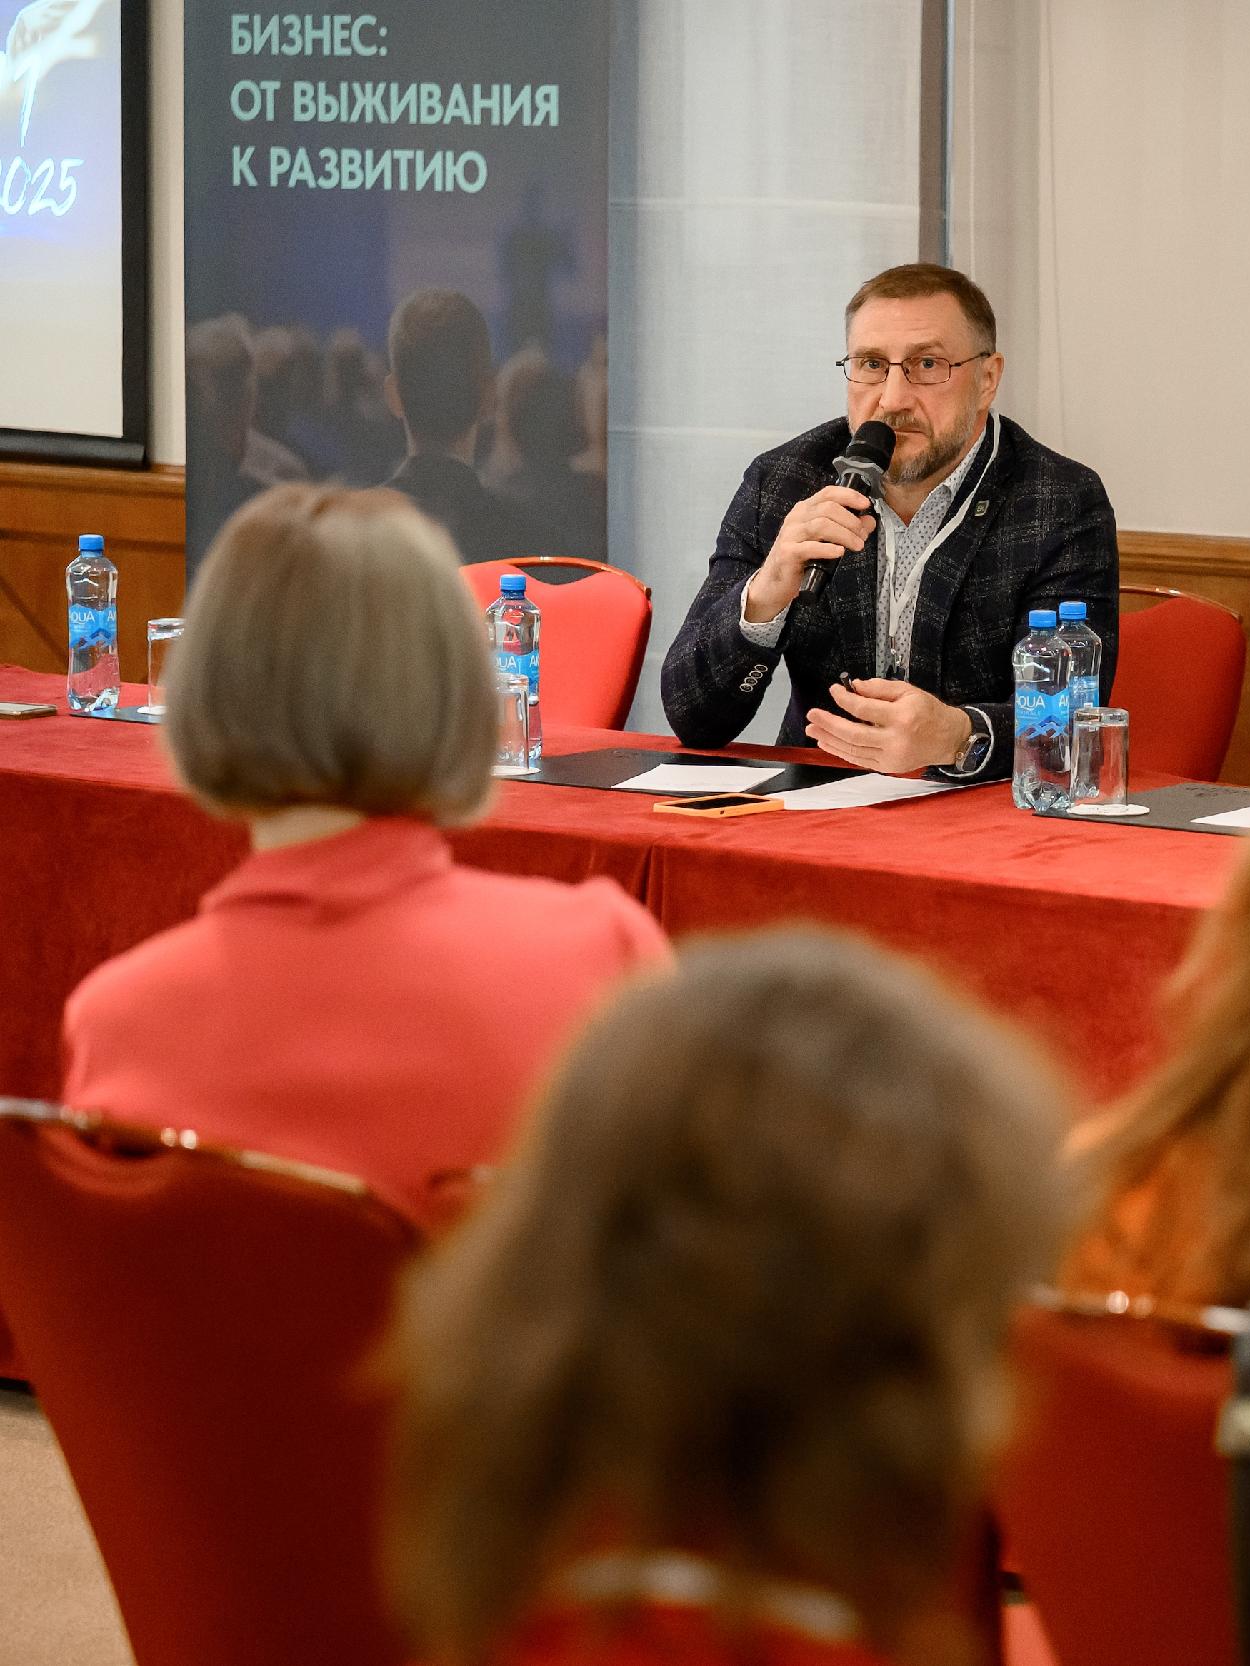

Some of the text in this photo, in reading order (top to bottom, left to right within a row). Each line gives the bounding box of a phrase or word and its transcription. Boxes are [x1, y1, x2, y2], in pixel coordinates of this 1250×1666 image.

[231, 13, 388, 57] БИЗНЕС:
[230, 80, 560, 127] ОТ ВЫЖИВАНИЯ
[0, 155, 85, 216] 025
[232, 145, 488, 194] К РАЗВИТИЮ
[70, 611, 96, 625] QUA
